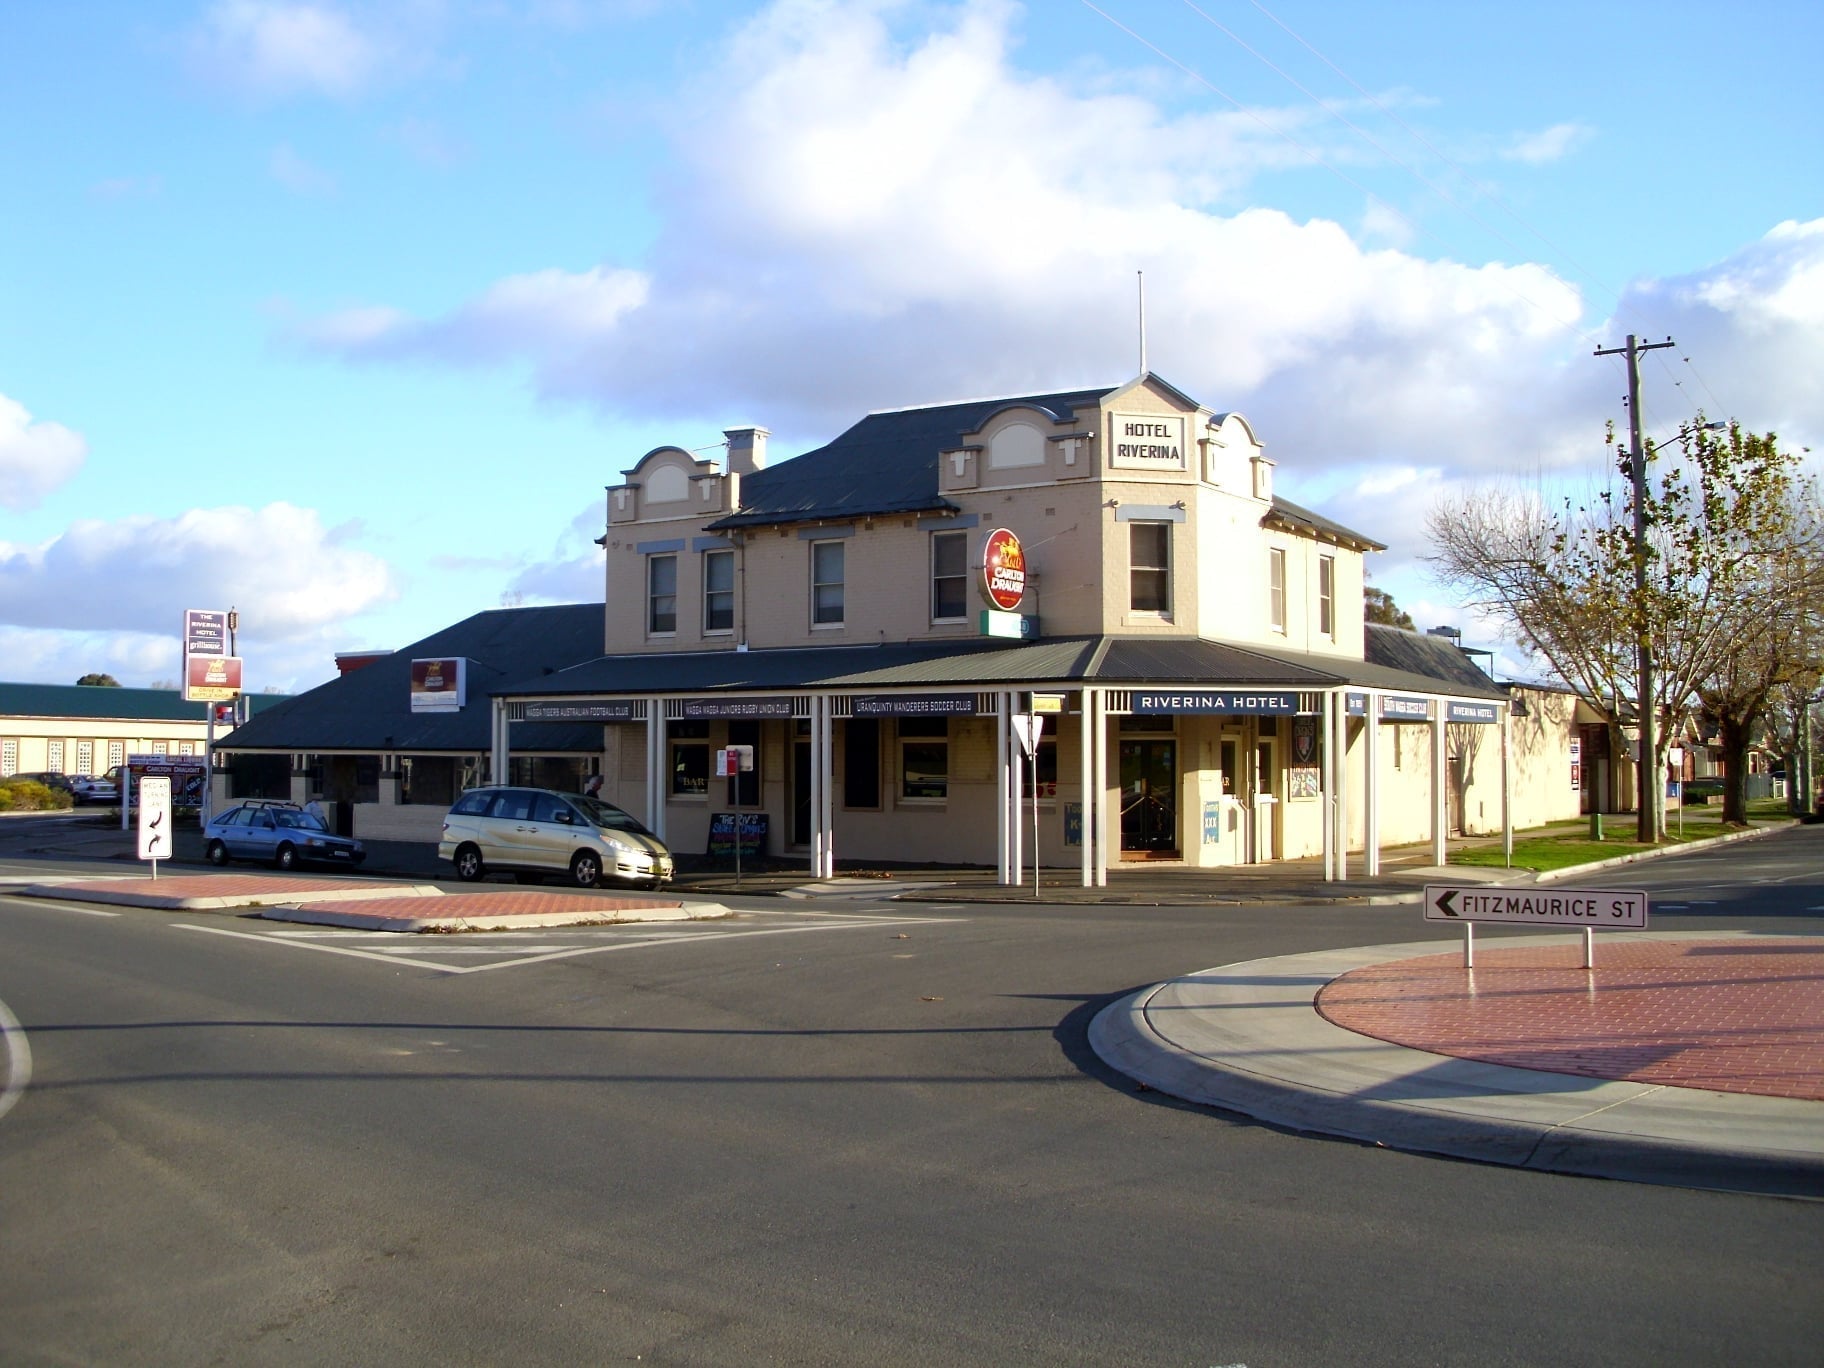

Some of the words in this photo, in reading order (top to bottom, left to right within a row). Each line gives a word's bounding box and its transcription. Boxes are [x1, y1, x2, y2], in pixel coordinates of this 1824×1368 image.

[1125, 423, 1172, 438] HOTEL
[1118, 443, 1180, 460] RIVERINA
[994, 566, 1025, 582] CARLTON
[991, 577, 1025, 594] DRAUGHT
[191, 621, 222, 629] RIVERINA
[776, 703, 790, 713] CLUB
[893, 702, 929, 712] WANDERERS
[930, 701, 954, 711] SOCCER
[955, 700, 972, 711] CLUB
[1141, 696, 1226, 708] RIVERINA
[1233, 696, 1290, 708] HOTEL
[615, 706, 629, 716] CLUB
[1453, 705, 1477, 717] RIVERINA
[1477, 708, 1494, 718] HOTEL
[146, 765, 172, 773] CARLTON
[173, 766, 201, 774] DRAUGHT
[683, 777, 705, 786] BAR
[720, 814, 735, 825] THE
[1204, 816, 1217, 829] XXX
[1463, 895, 1597, 917] FITZMAURICE
[1611, 900, 1636, 918] ST
